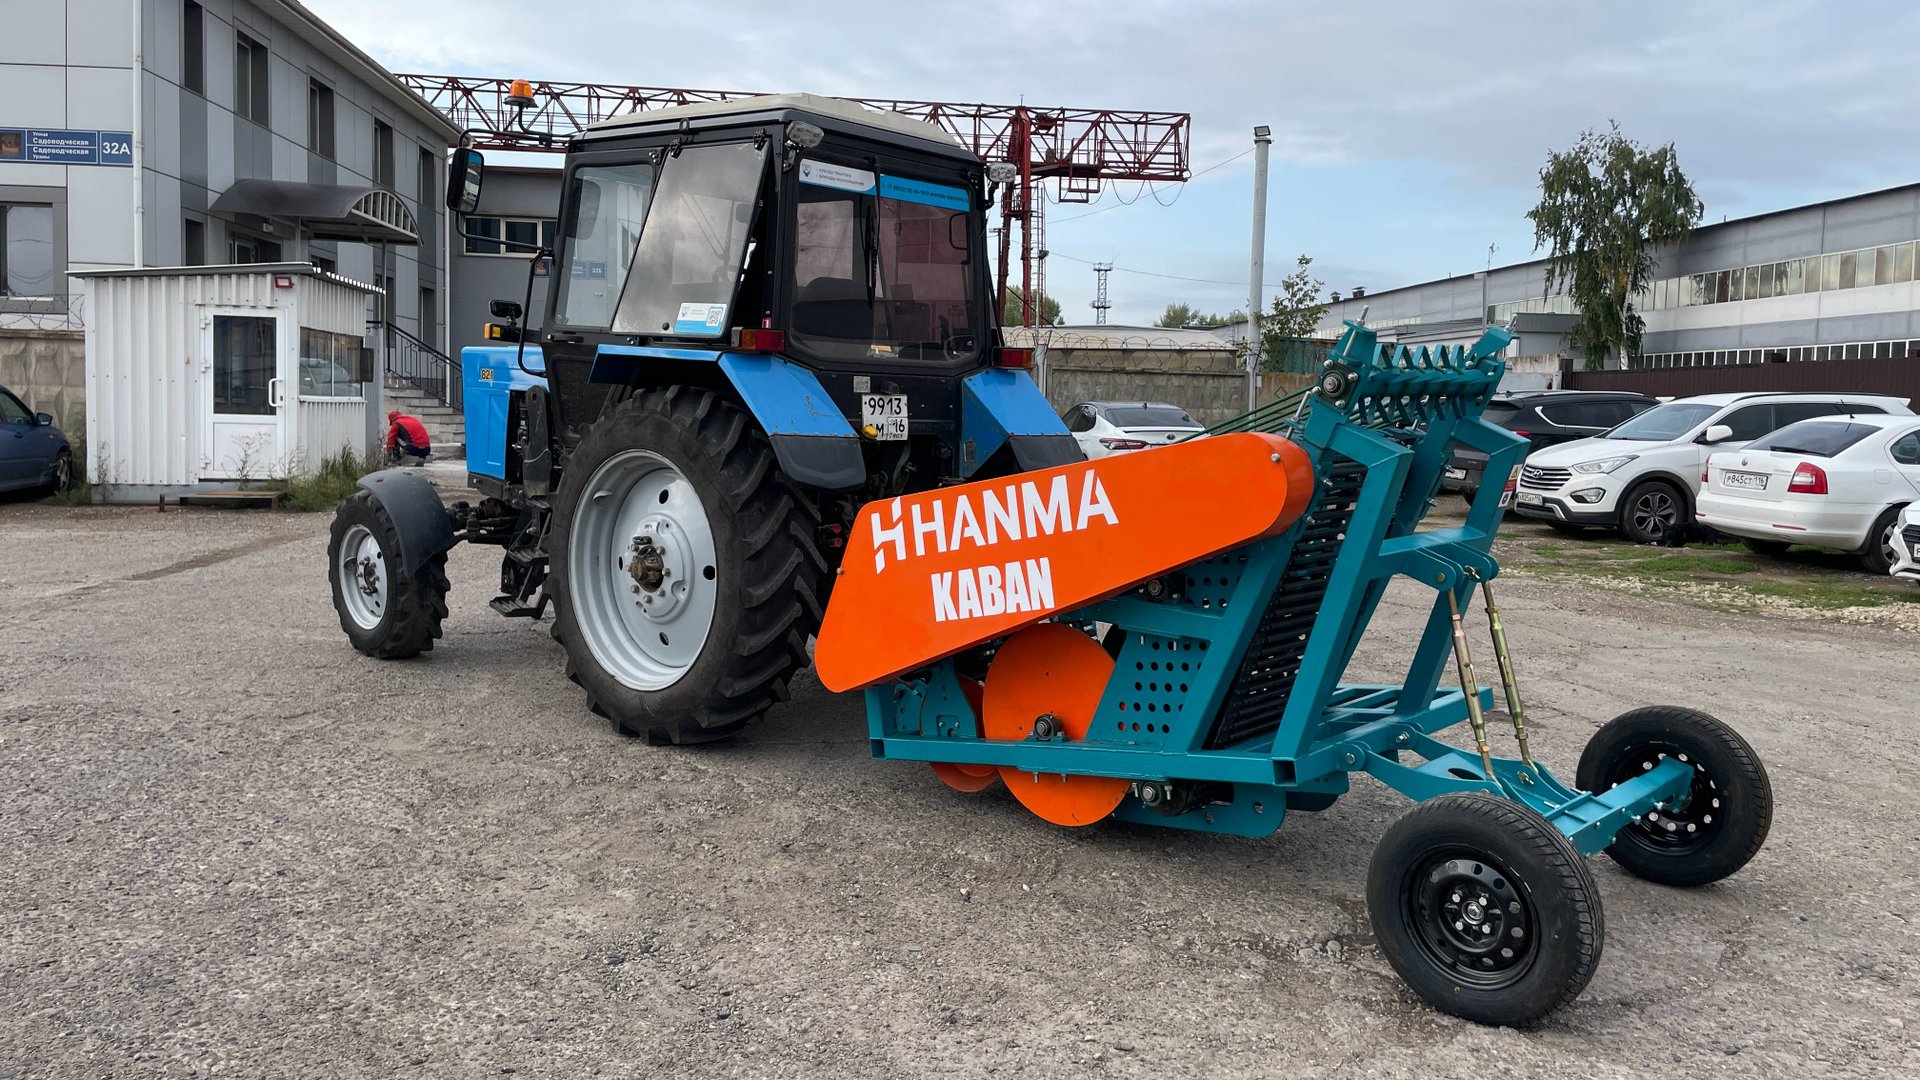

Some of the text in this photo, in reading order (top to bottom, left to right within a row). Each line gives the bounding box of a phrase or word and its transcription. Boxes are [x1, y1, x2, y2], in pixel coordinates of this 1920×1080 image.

[32, 137, 89, 146] Садоводческая
[32, 147, 89, 155] Садоводческая
[868, 397, 902, 416] 9913
[893, 419, 906, 433] 16
[931, 557, 1055, 622] KABAN
